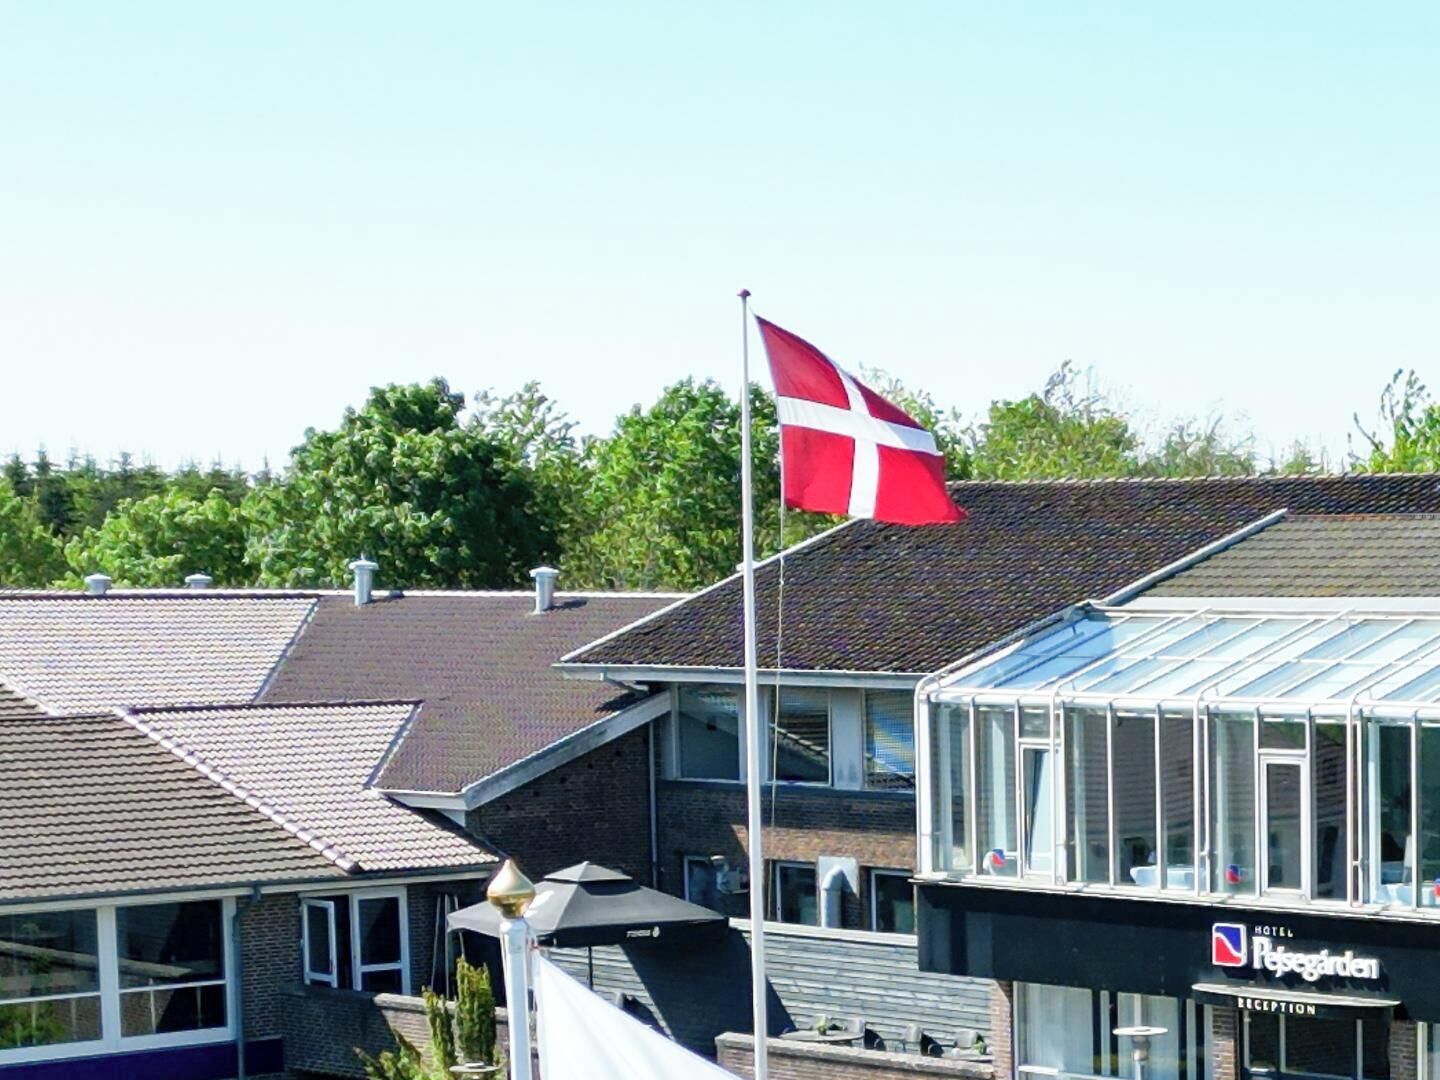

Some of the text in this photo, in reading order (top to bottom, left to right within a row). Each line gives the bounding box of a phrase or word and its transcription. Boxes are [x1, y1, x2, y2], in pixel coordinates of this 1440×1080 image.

[1254, 925, 1294, 938] HOTEL
[1251, 936, 1380, 982] Pejsegården
[1237, 997, 1316, 1015] RECEPTION
